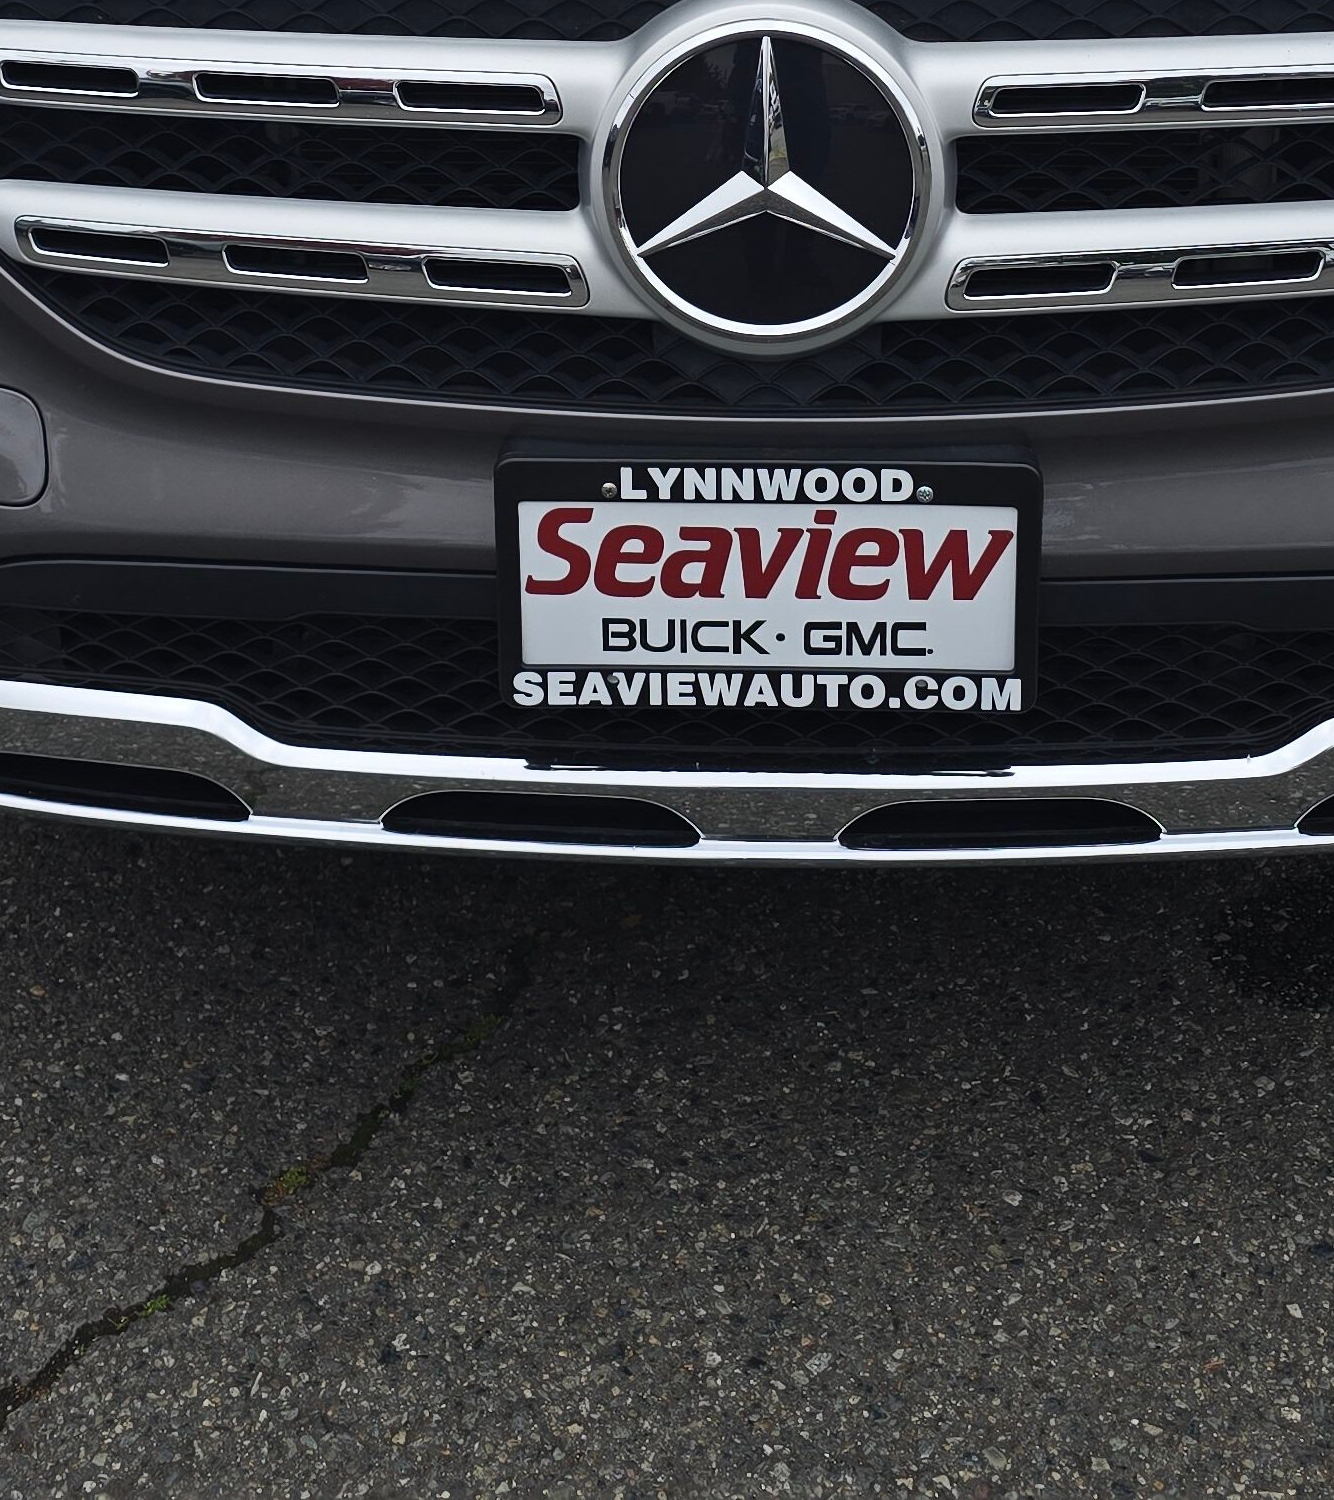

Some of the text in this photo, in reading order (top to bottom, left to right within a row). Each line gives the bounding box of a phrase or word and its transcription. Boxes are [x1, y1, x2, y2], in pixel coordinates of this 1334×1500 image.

[620, 467, 914, 502] LYNNWOOD
[525, 508, 1014, 601] Seaview
[513, 671, 1022, 711] SEAVIEWAUTO.COM
